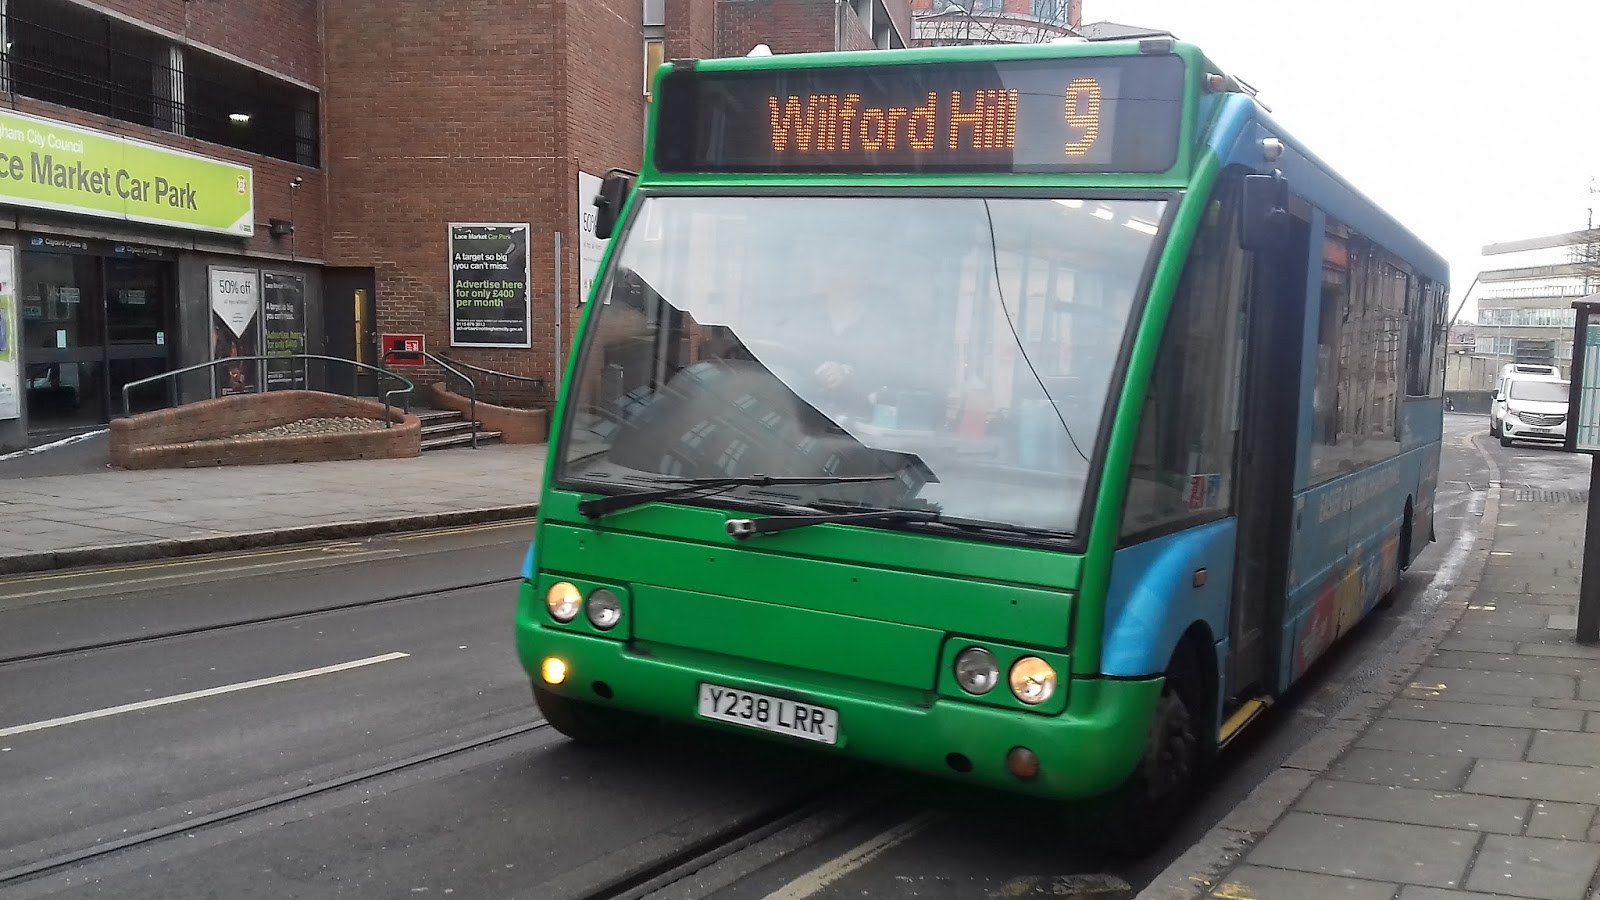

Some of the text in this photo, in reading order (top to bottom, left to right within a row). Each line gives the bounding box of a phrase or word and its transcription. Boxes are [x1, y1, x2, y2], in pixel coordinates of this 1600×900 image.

[768, 78, 1100, 156] Wilford Hill 9
[27, 129, 46, 149] City
[47, 133, 84, 154] Council
[31, 151, 111, 196] Market
[116, 169, 150, 203] Car
[155, 176, 198, 210] Park
[455, 252, 461, 260] A
[462, 252, 484, 262] target
[495, 252, 508, 262] big
[455, 261, 509, 271] you can't miss.
[219, 279, 251, 295] 50% off
[456, 280, 523, 289] Advertise here
[456, 288, 514, 299] for only £400
[456, 298, 503, 308] per month
[710, 687, 825, 735] Y238 LRR
